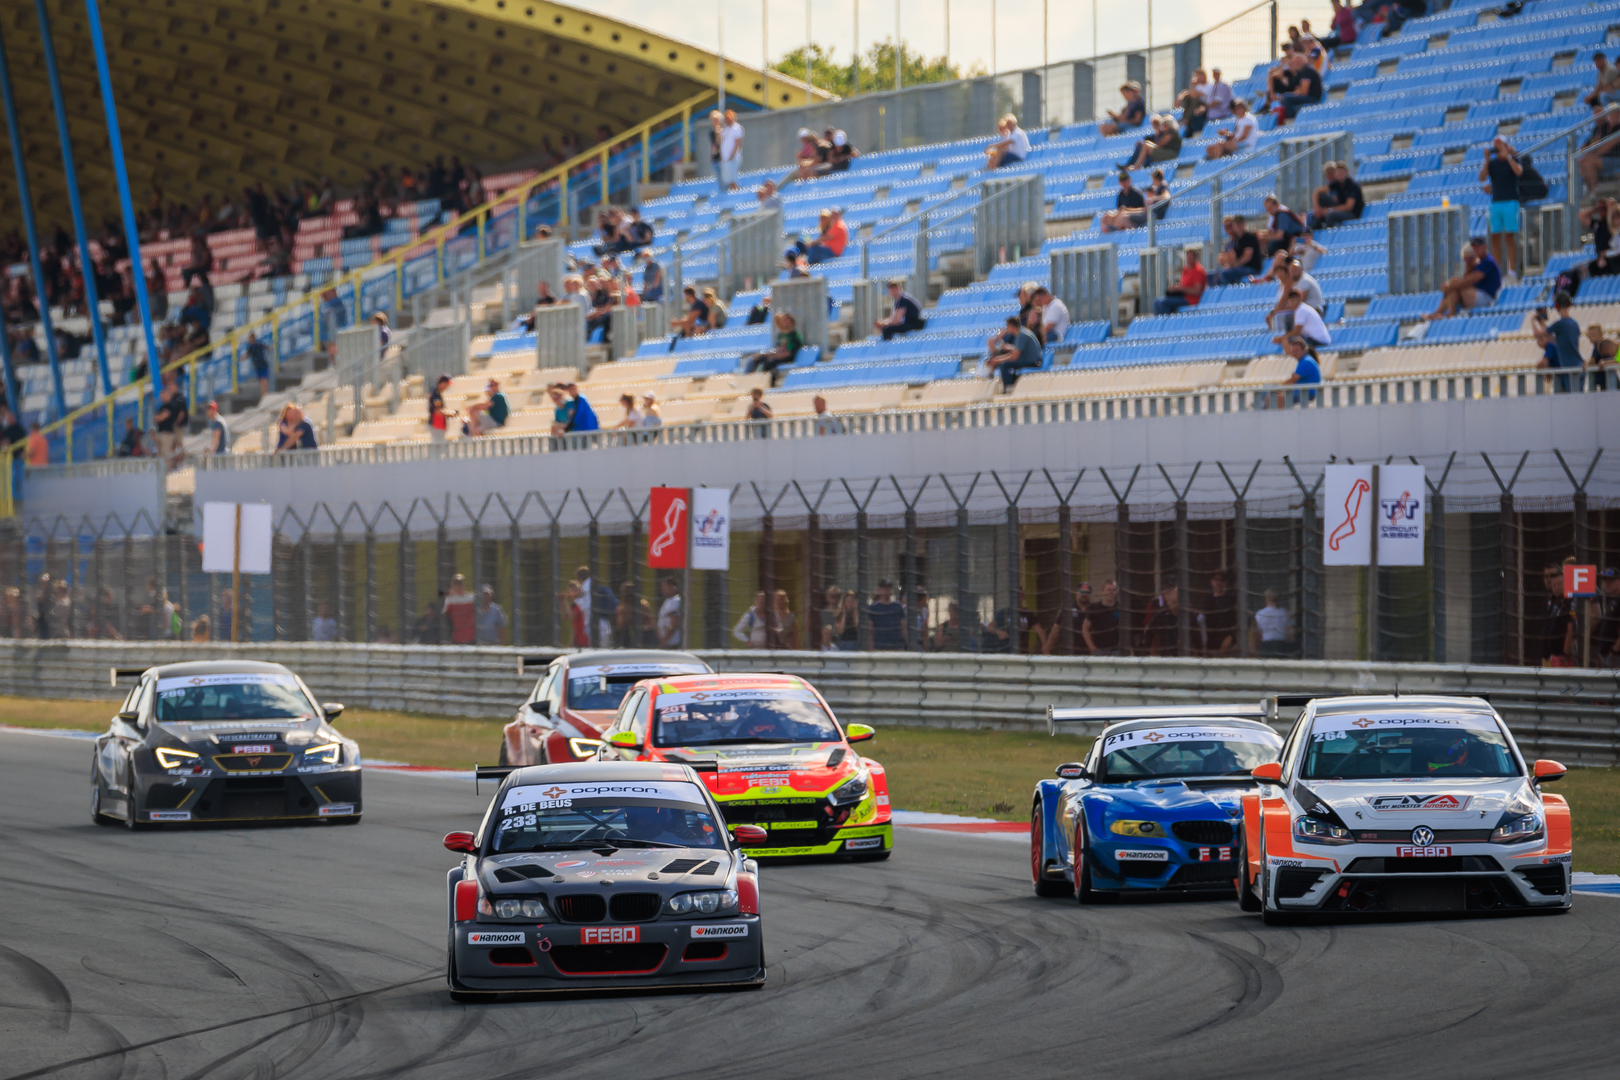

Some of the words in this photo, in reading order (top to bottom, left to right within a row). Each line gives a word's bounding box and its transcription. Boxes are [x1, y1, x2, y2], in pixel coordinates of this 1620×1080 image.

[1381, 525, 1420, 533] CIRCUIT
[1573, 568, 1589, 591] F
[660, 704, 687, 715] 201
[1378, 718, 1459, 726] ooperon
[1108, 732, 1133, 746] 211
[1168, 731, 1243, 739] ooperon
[1314, 730, 1348, 743] 264
[234, 745, 271, 754] FEBO
[748, 778, 790, 787] FEBO
[571, 786, 658, 795] ooperon
[504, 806, 517, 816] R.
[520, 803, 537, 813] DE
[540, 799, 573, 810] BEUS
[502, 814, 537, 831] 233
[1400, 847, 1448, 858] FEBO
[585, 927, 636, 943] FEBO
